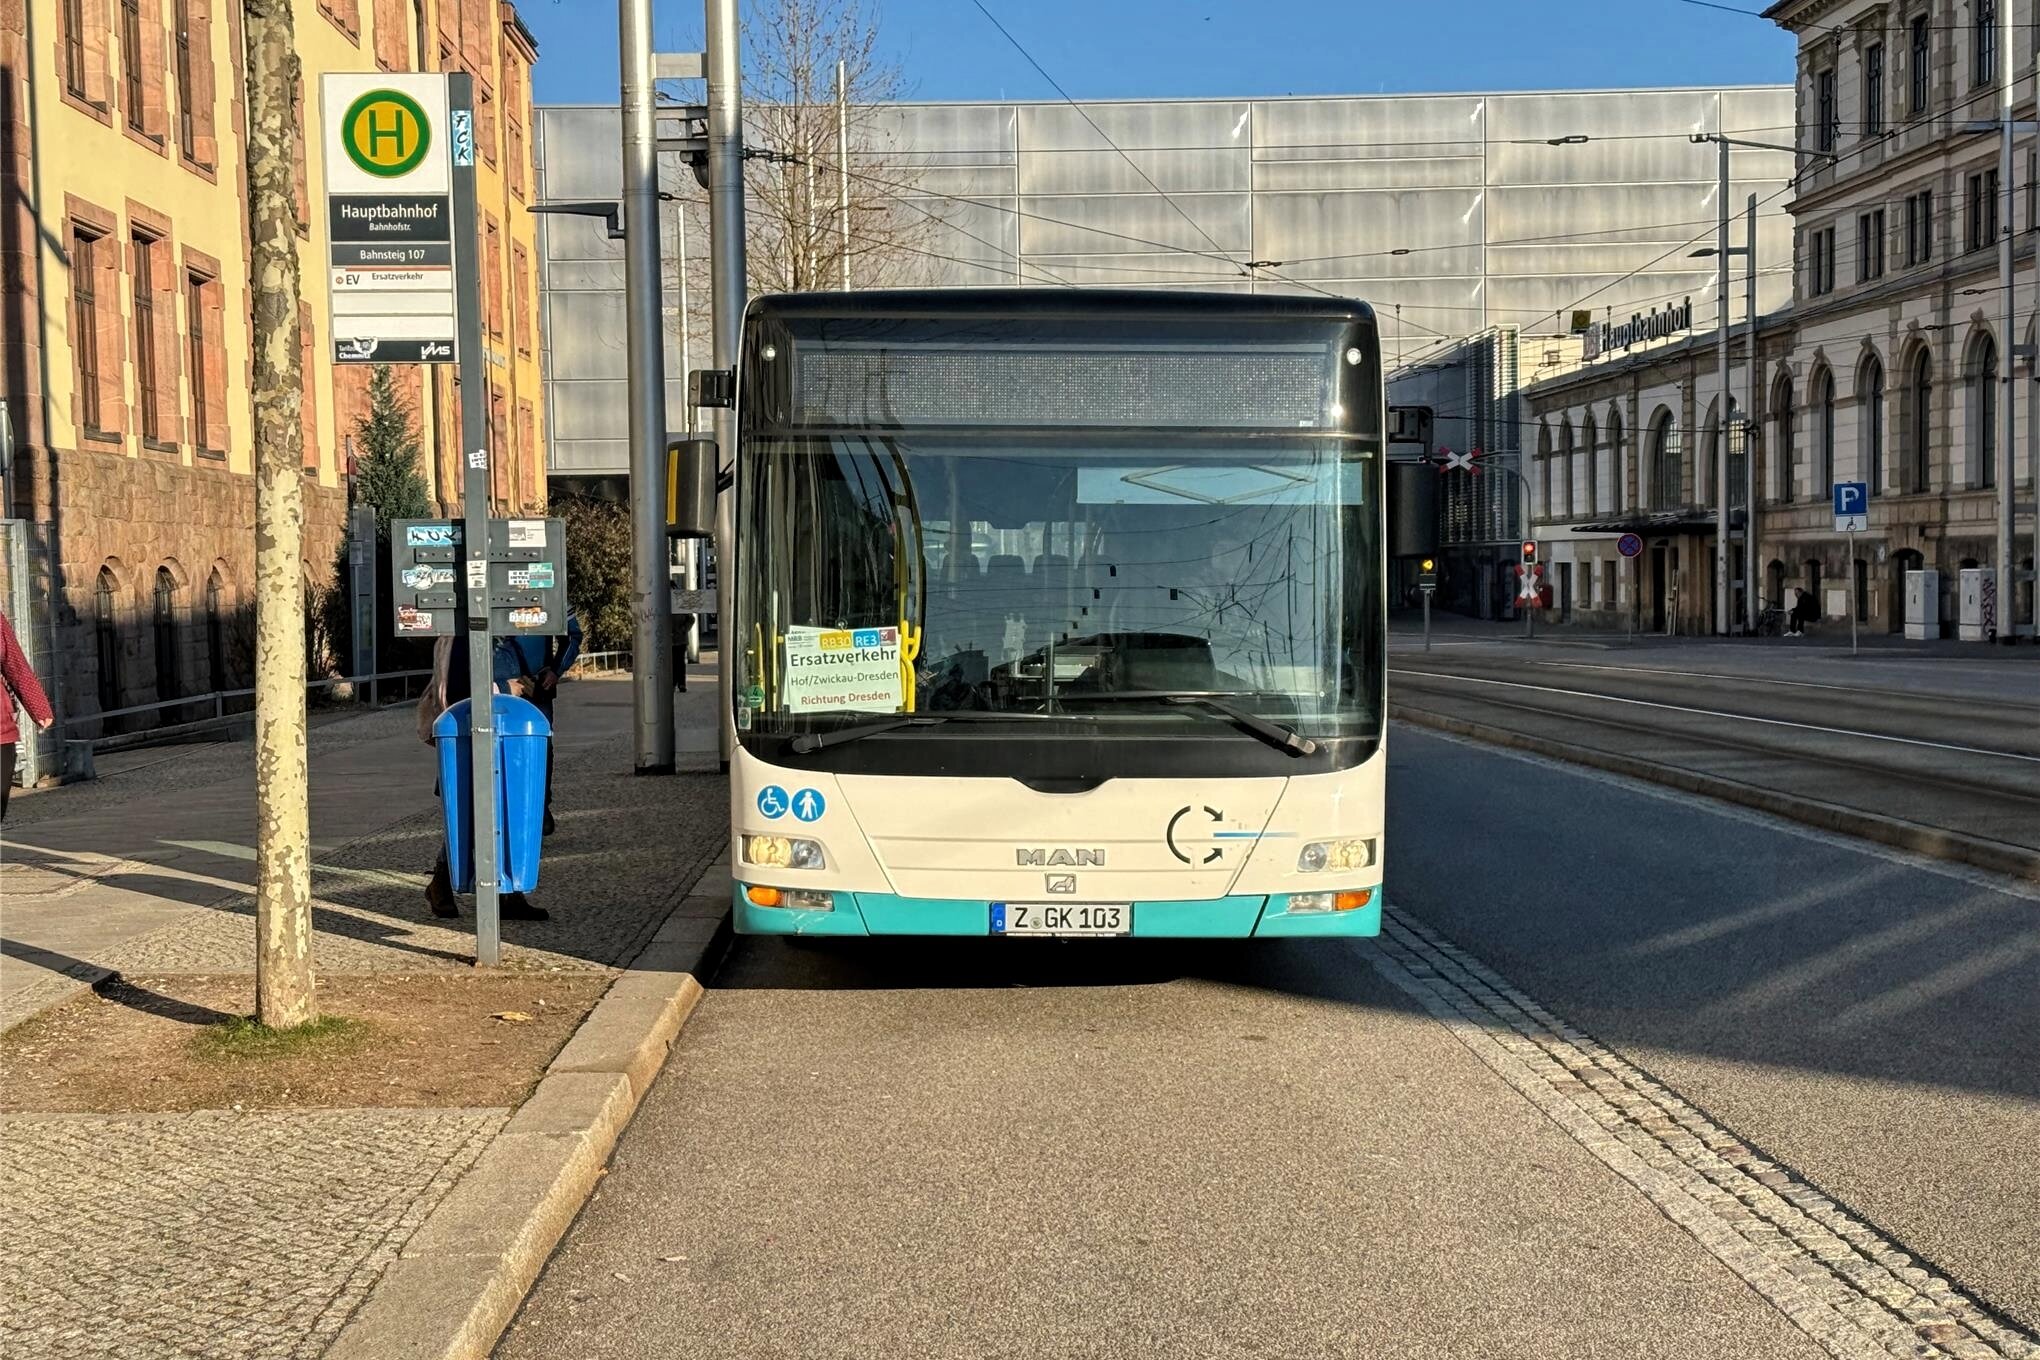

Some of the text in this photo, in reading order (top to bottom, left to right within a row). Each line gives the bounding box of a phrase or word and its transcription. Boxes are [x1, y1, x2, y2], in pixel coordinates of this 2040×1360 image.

[369, 109, 405, 157] H
[341, 203, 438, 221] Hauptbahnhof
[369, 222, 411, 231] Bahnhofstr.
[360, 249, 425, 262] Bahnsteig 107
[346, 272, 424, 285] EV Ersatzverkehr
[1601, 296, 1692, 352] Hauptbahnhof
[1841, 487, 1860, 511] P
[855, 635, 878, 647] RE3
[790, 648, 897, 667] Ersatzverkehr
[791, 671, 899, 686] Hof/Zwickau-Dresden
[801, 691, 891, 705] Richtung Dresden
[1016, 849, 1105, 866] MAN
[1014, 907, 1121, 929] Z GK 103
